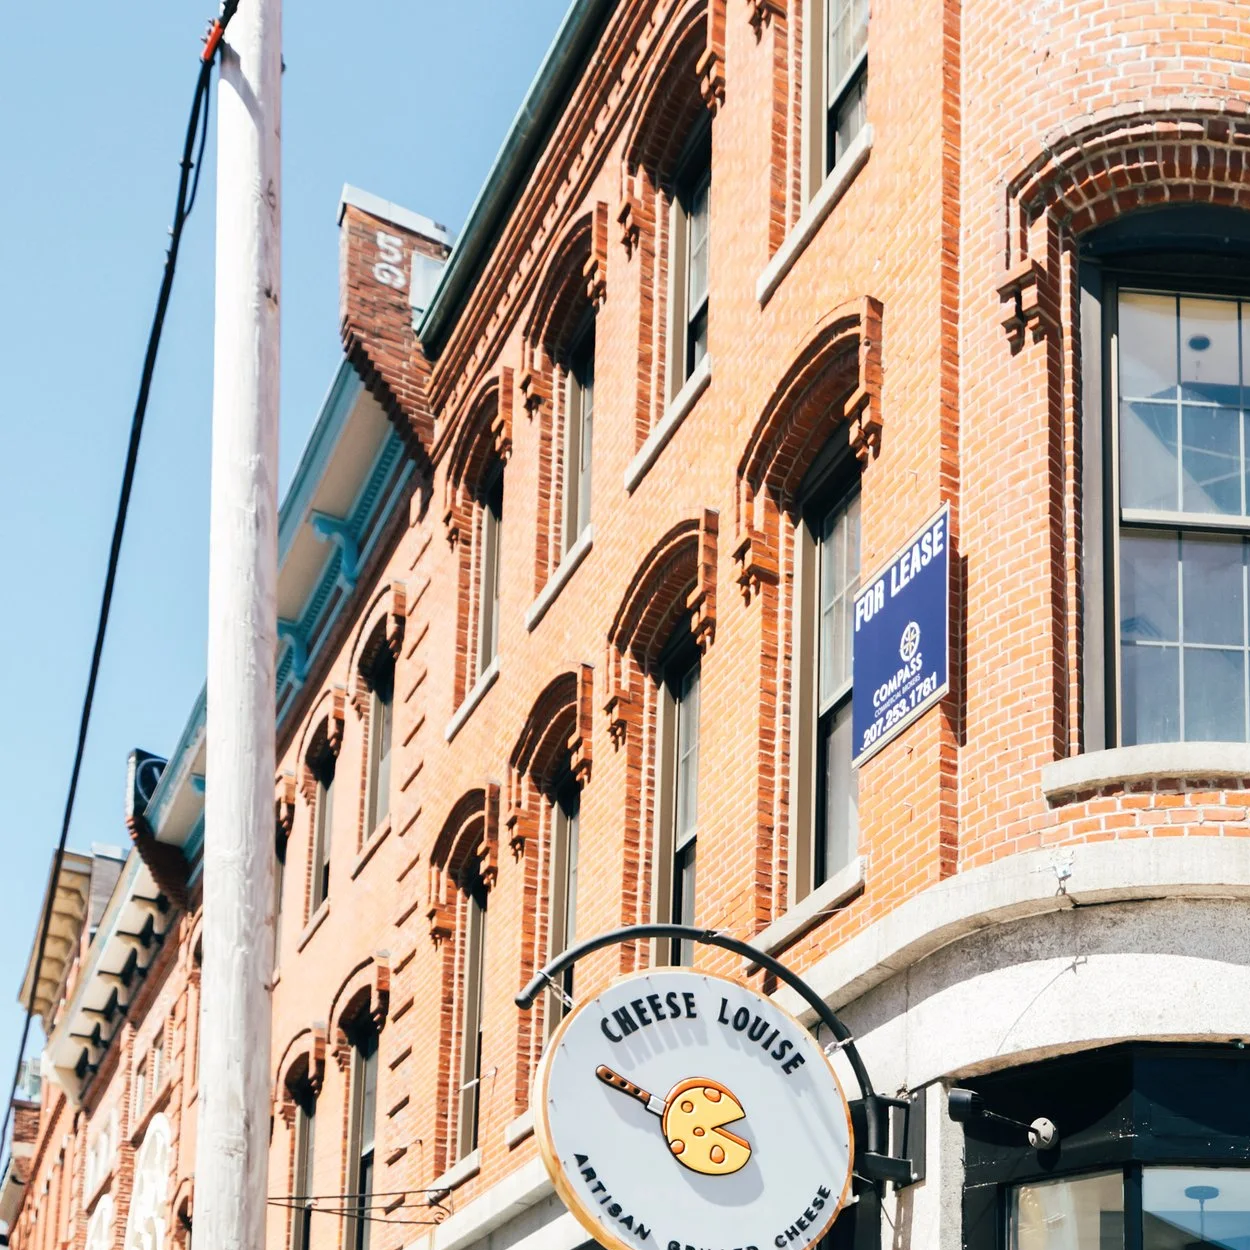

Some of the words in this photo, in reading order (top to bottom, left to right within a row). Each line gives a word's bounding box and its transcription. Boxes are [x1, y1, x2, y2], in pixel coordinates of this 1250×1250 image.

[855, 579, 885, 632] FOR
[890, 518, 945, 598] LEASE
[863, 671, 937, 748] 207.253.1781
[873, 652, 923, 708] COMPASS
[600, 992, 698, 1043] CHEESE
[717, 997, 806, 1075] LOUISE
[573, 1153, 651, 1240] ARTISAN
[774, 1184, 831, 1248] CHEESE
